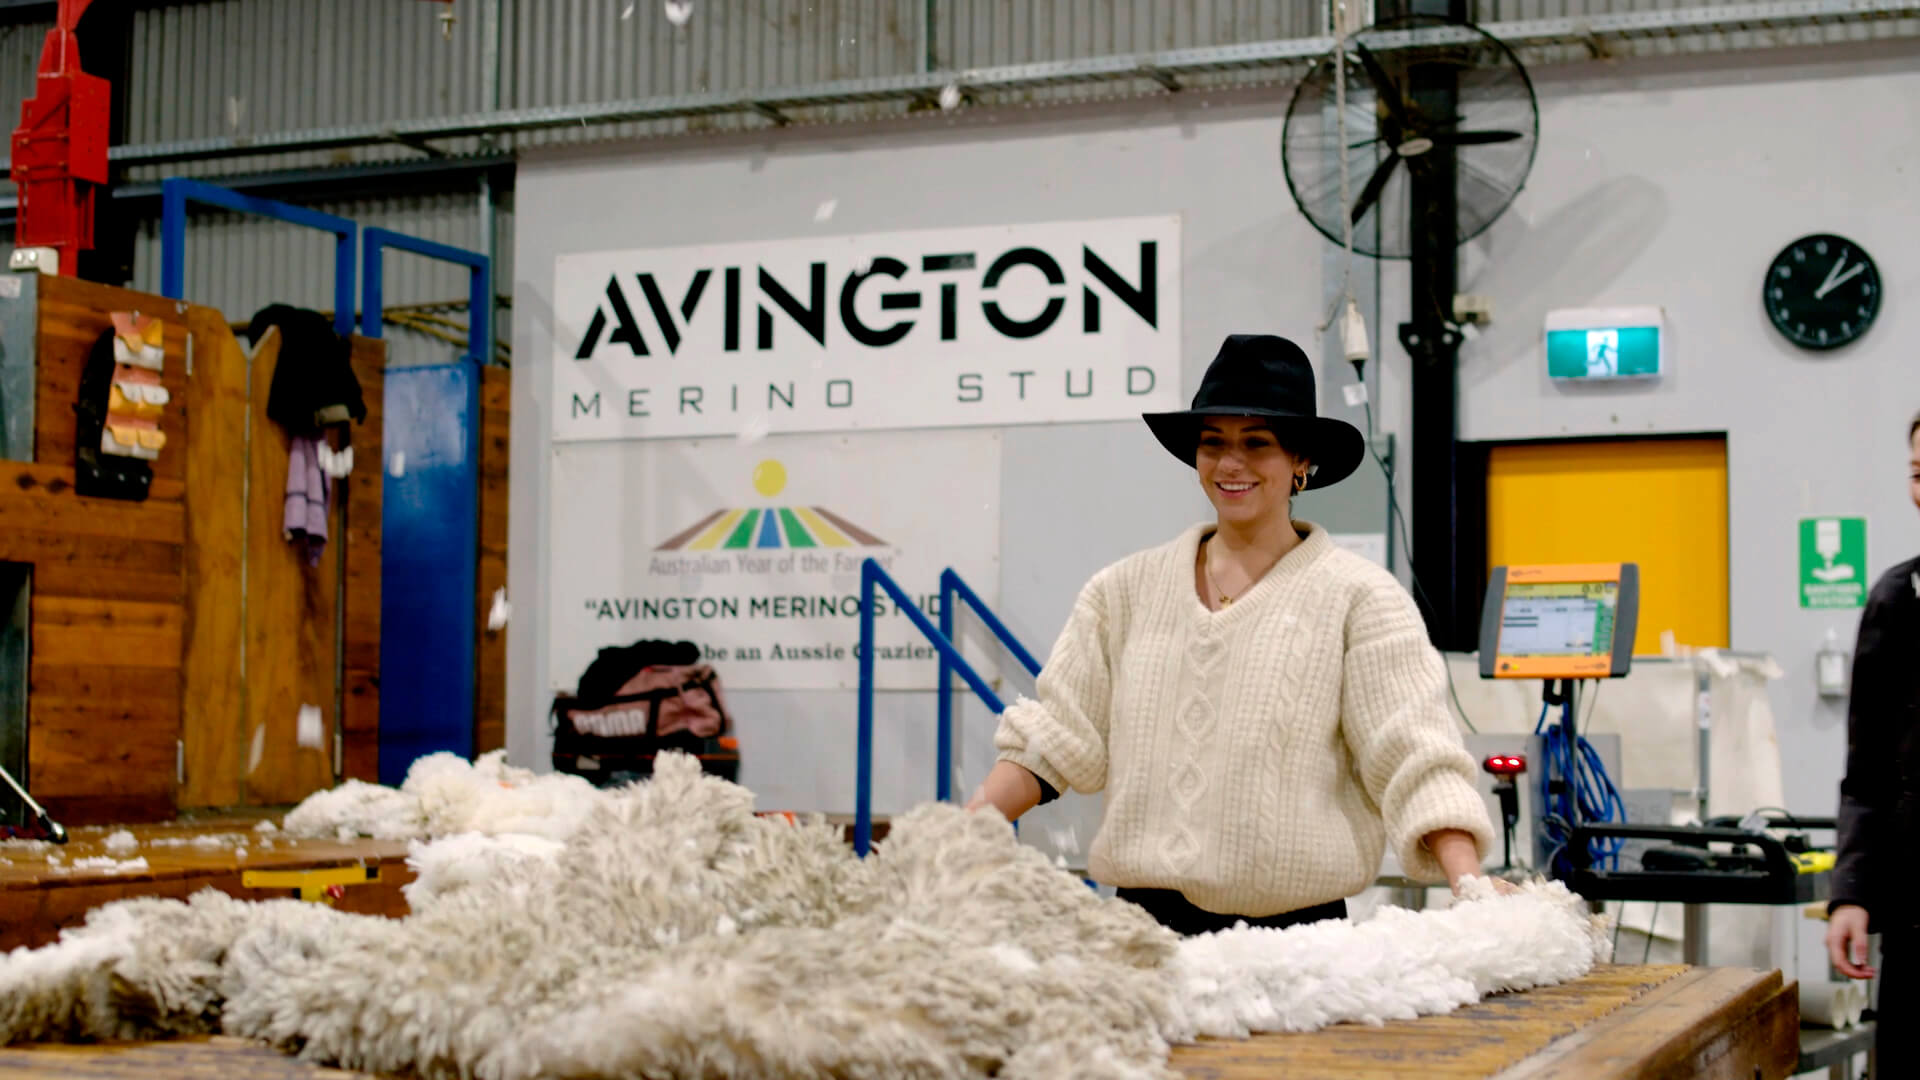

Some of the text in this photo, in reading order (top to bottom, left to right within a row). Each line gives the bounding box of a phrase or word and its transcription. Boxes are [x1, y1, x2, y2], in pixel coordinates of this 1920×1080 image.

[574, 241, 1158, 359] AVINGTON
[572, 366, 1157, 418] MERINO STUD
[648, 552, 894, 576] Australian Year of the Farer
[750, 595, 861, 619] MERINO
[735, 647, 762, 661] an
[769, 643, 845, 661] Aussie
